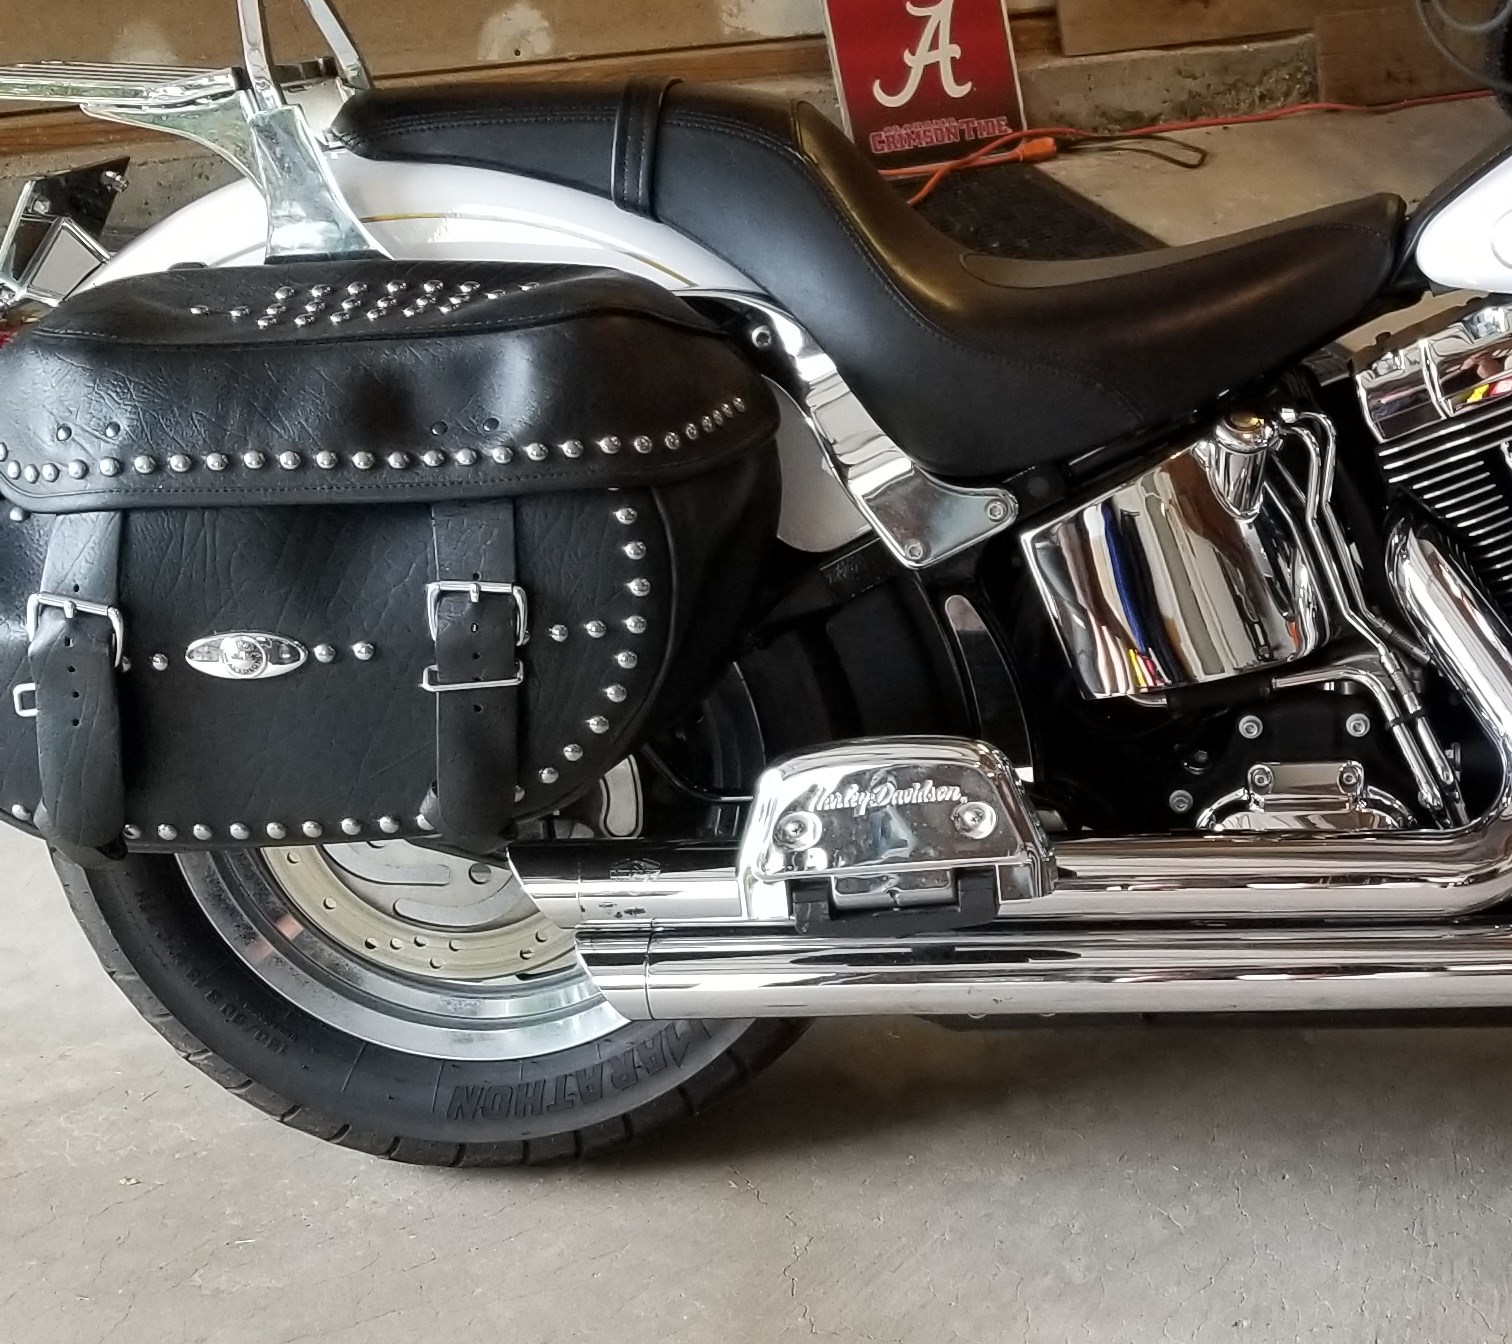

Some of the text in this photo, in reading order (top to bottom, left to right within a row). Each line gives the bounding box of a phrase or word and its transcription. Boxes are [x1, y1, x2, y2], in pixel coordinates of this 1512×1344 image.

[869, 116, 1013, 155] CRIMSON TIDE
[445, 1018, 712, 1121] MARATHON
